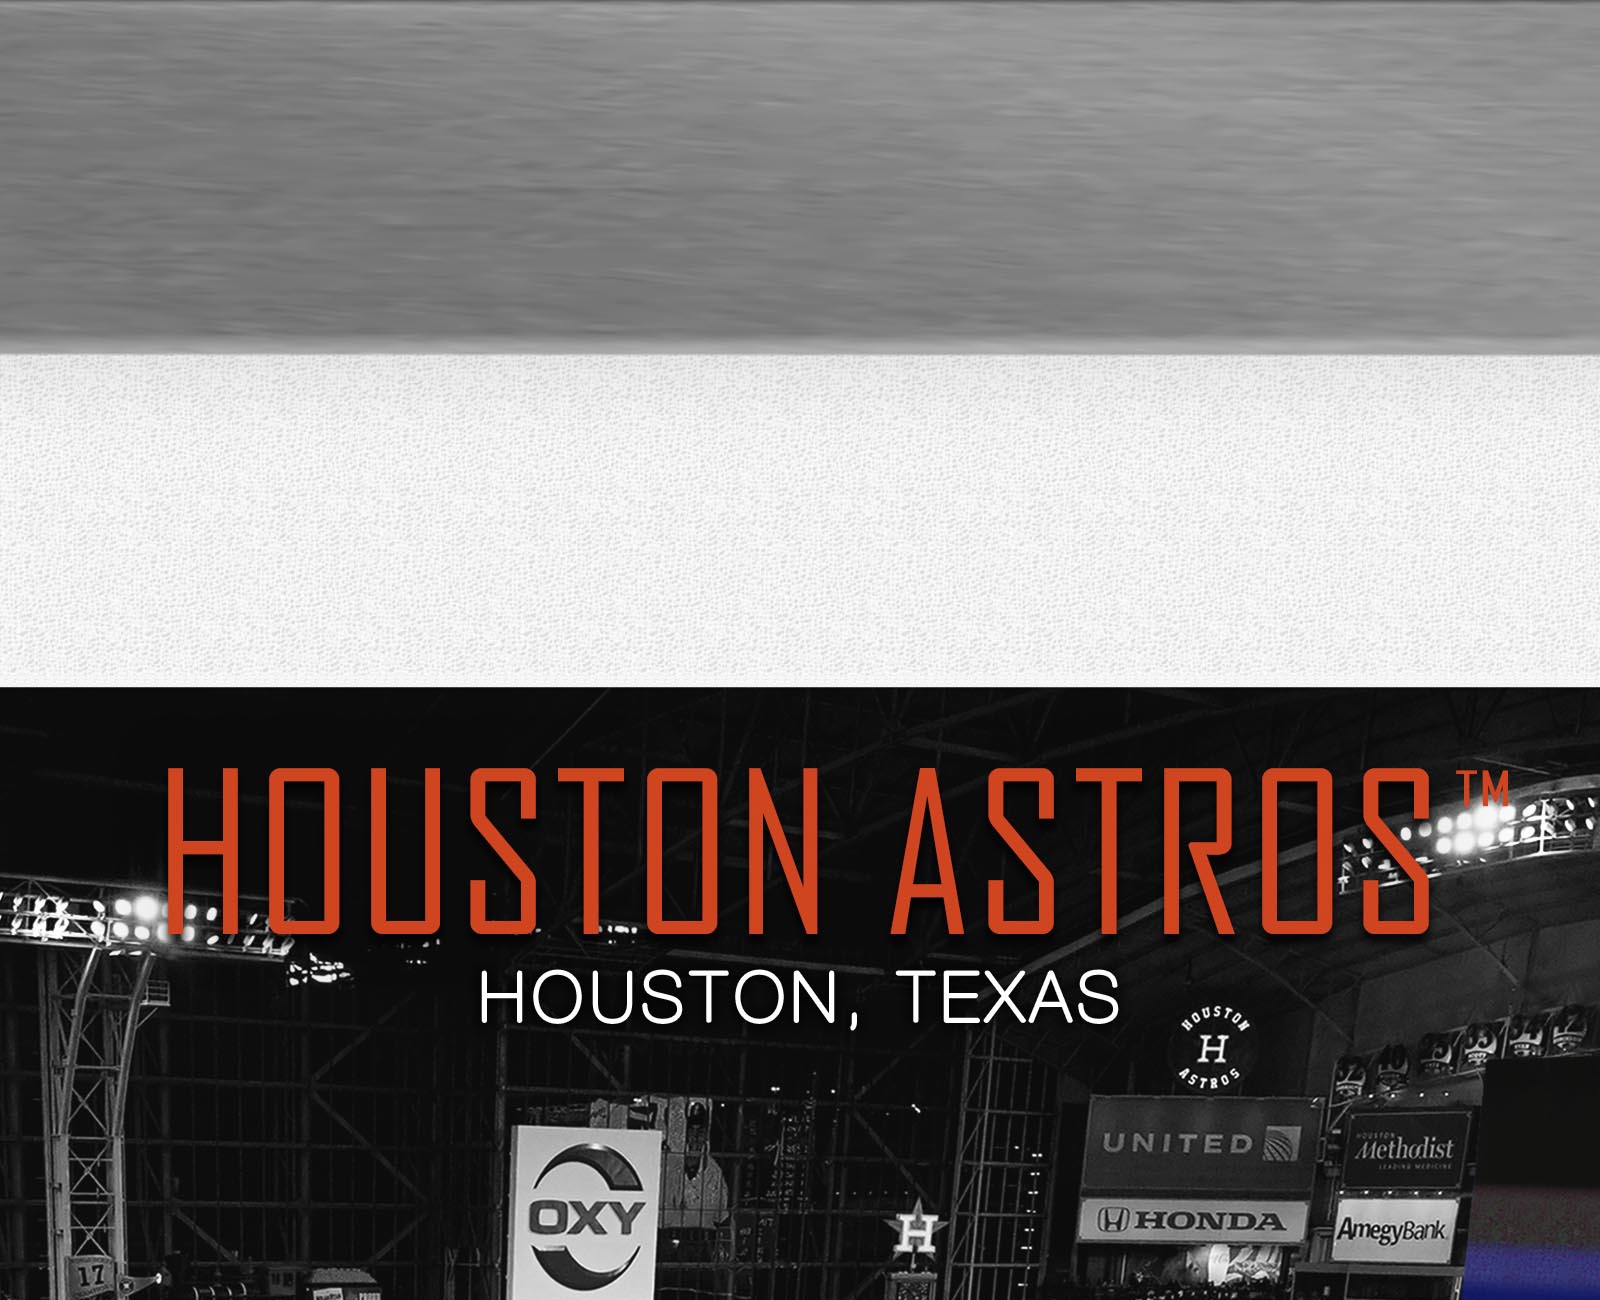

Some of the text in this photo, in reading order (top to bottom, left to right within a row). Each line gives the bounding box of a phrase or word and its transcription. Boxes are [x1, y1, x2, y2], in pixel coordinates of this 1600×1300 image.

[1181, 1005, 1251, 1033] HOUSTON
[1197, 1035, 1228, 1064] H
[1178, 1067, 1241, 1089] ASTROS
[1103, 1133, 1253, 1154] UNITED
[1355, 1136, 1454, 1160] Methodist
[528, 1200, 646, 1235] OXY
[1134, 1211, 1287, 1230] HONDA
[1336, 1216, 1446, 1245] AmegyBank
[893, 1214, 939, 1253] H
[78, 1265, 106, 1287] 17
